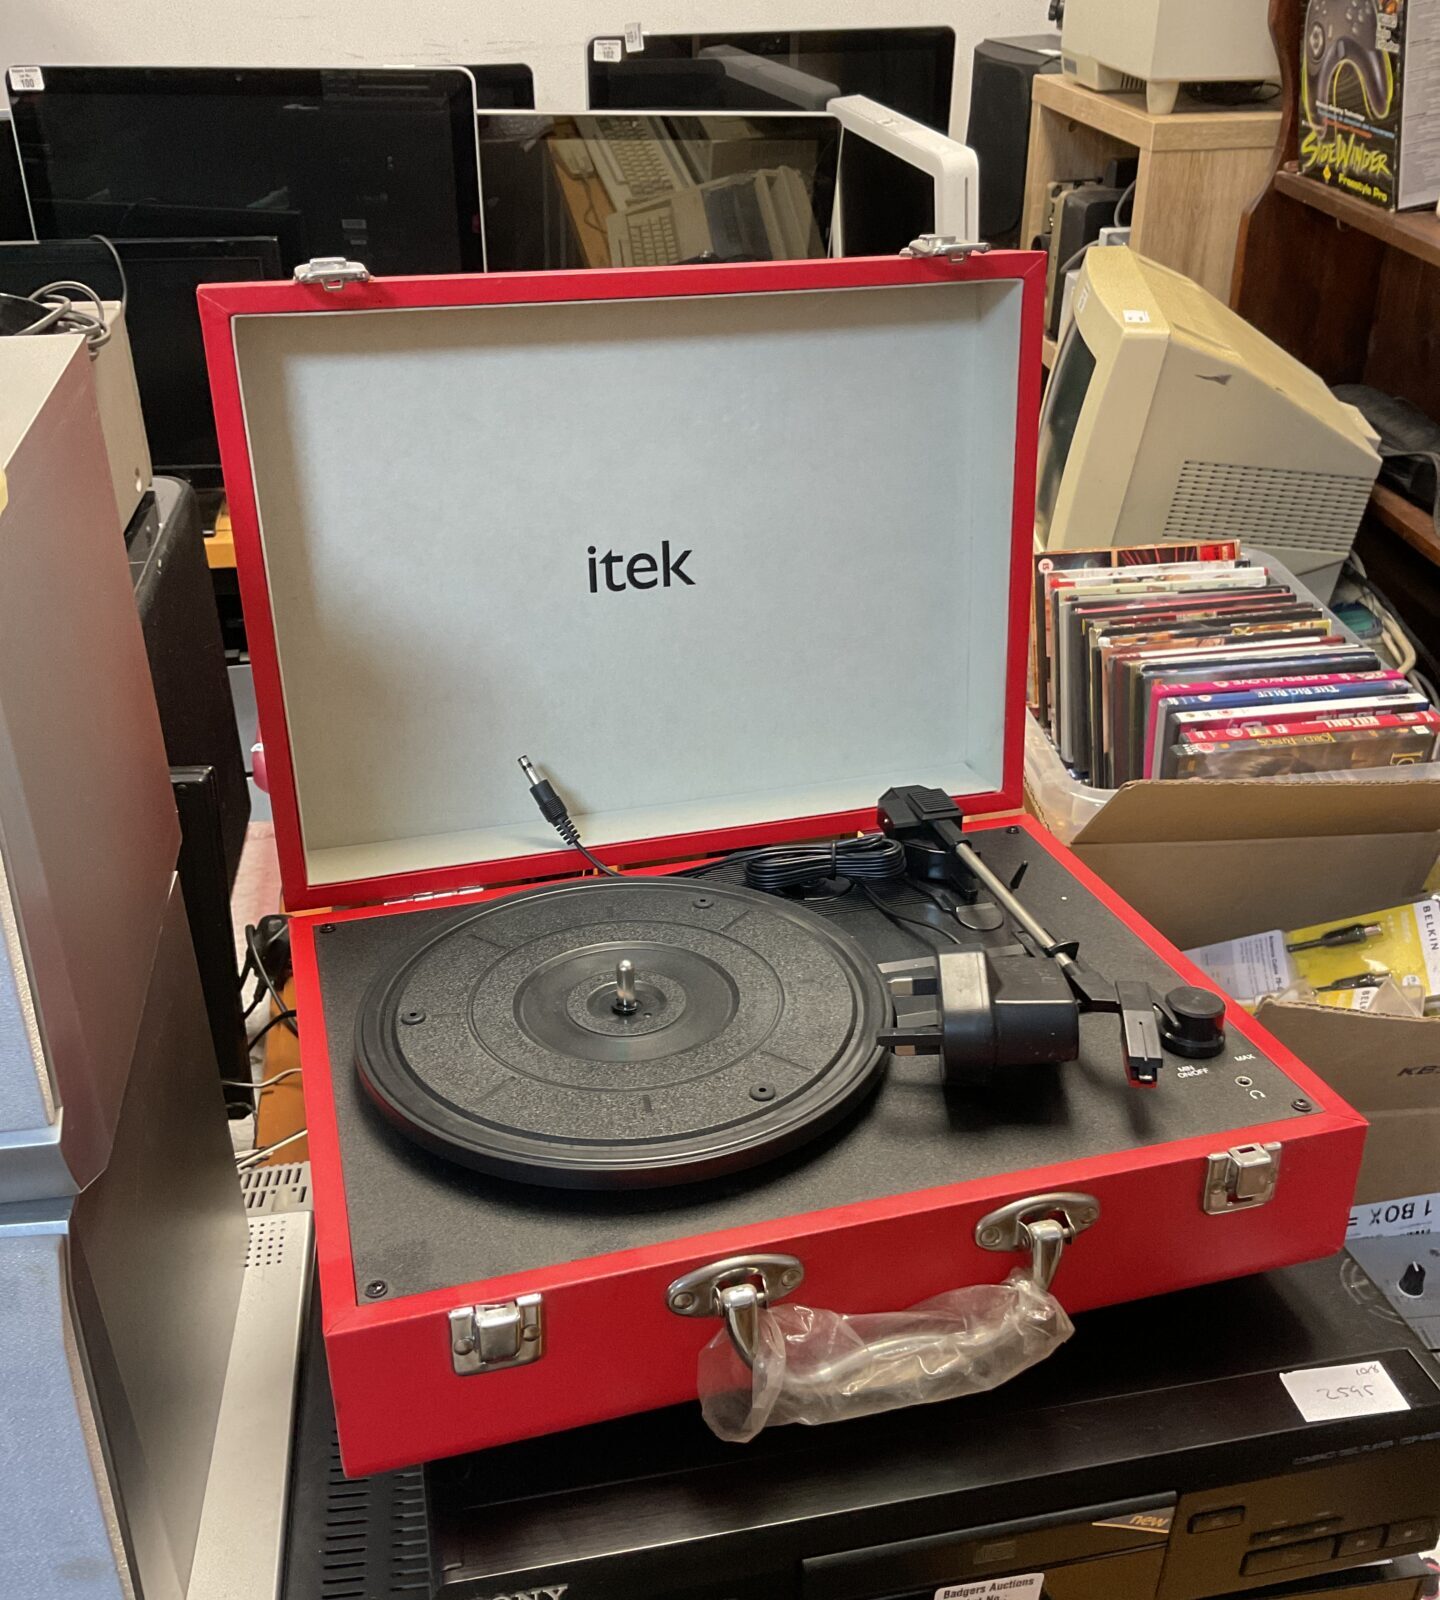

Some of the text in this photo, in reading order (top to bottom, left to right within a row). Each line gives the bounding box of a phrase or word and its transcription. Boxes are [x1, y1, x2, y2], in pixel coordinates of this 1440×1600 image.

[1373, 186, 1388, 202] Pro
[587, 540, 696, 593] itek
[1257, 685, 1340, 698] THE BIG BLUE
[1422, 905, 1439, 951] BELKIN
[1234, 1053, 1257, 1062] MAX
[1369, 1202, 1415, 1225] BOX
[1129, 1515, 1168, 1527] new
[943, 1578, 1035, 1600] Badgers Auctions
